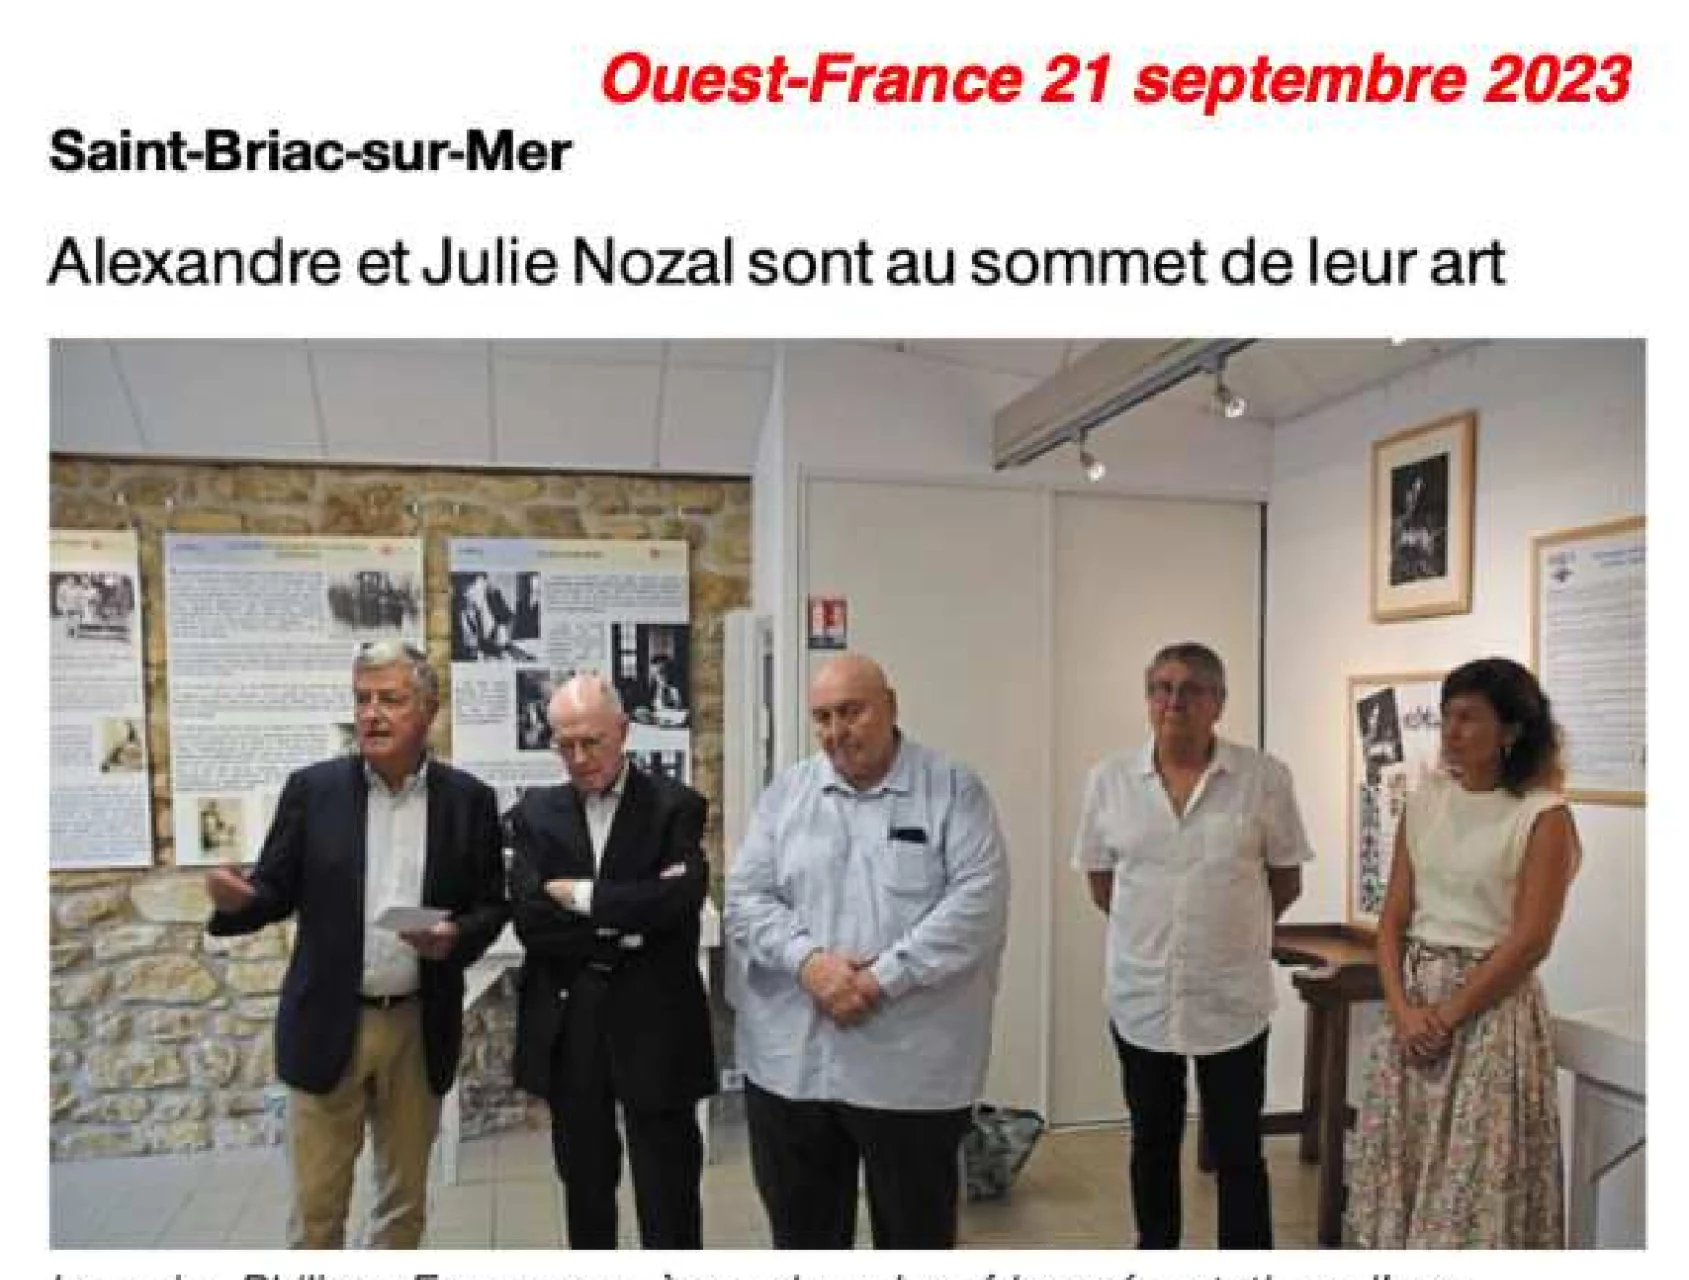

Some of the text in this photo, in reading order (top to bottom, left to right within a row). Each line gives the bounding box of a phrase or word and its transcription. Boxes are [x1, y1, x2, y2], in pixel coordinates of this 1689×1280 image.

[49, 129, 574, 175] Saint-Briac-sur-Mer
[47, 236, 1507, 288] Alexandre et Julie Nozal sont au sommet de leur art
